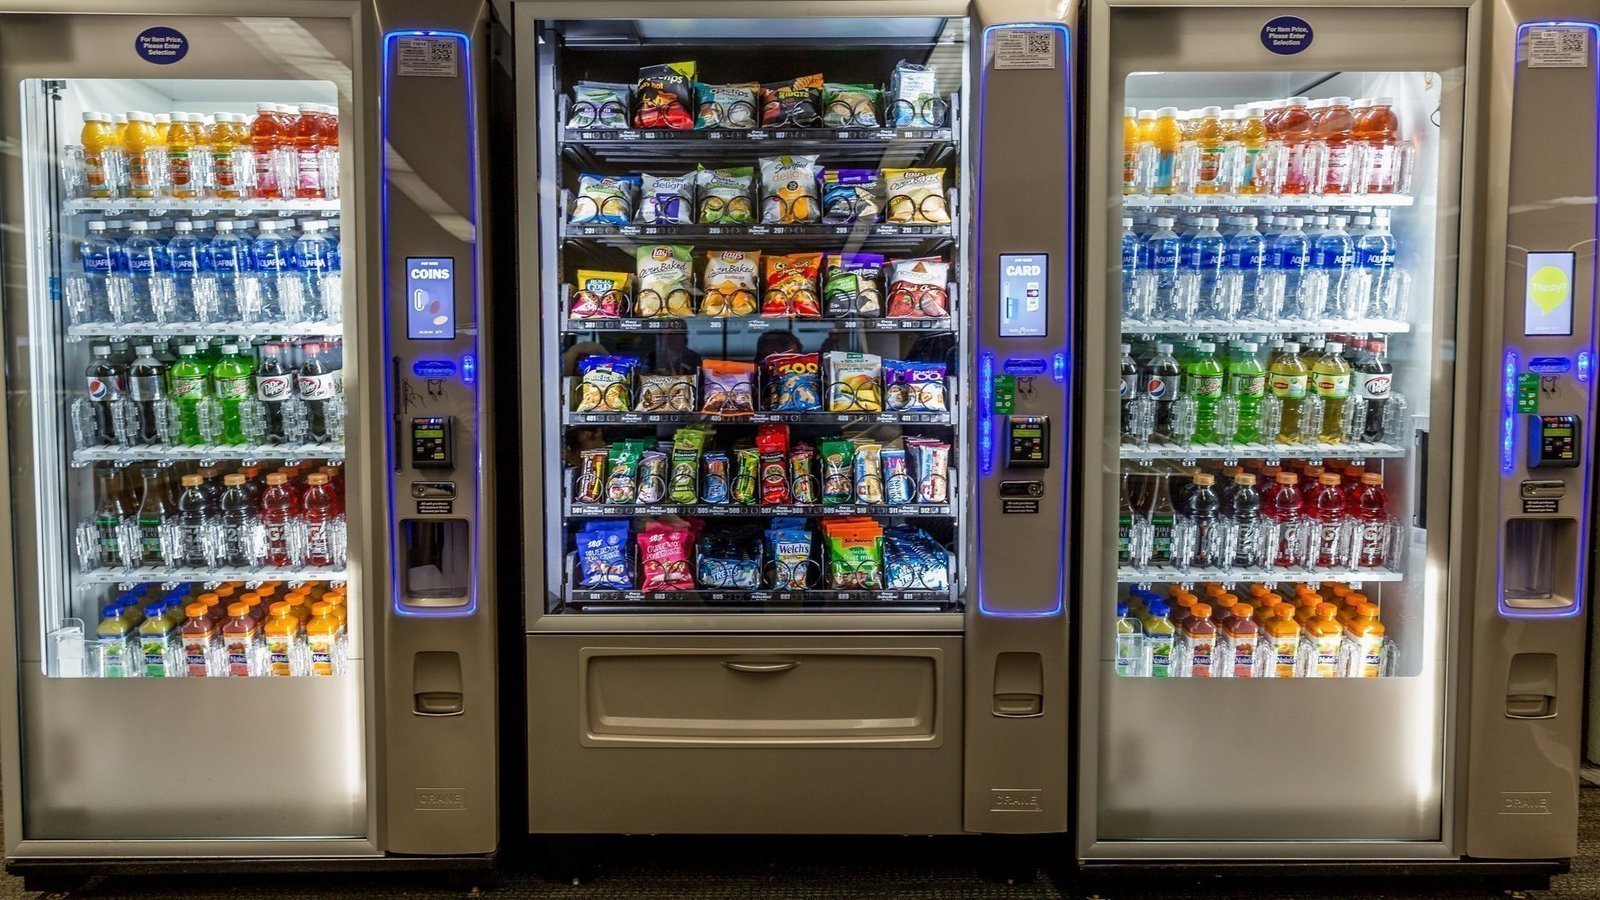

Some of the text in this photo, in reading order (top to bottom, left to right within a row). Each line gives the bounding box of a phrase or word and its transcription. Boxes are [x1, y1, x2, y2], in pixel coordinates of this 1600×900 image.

[660, 262, 687, 271] Baked
[1006, 266, 1041, 276] CARD
[411, 269, 450, 280] COINS
[780, 543, 810, 554] Welch's
[420, 794, 461, 804] CRANE
[996, 796, 1038, 805] CRANE
[1504, 798, 1547, 808] CRANE
